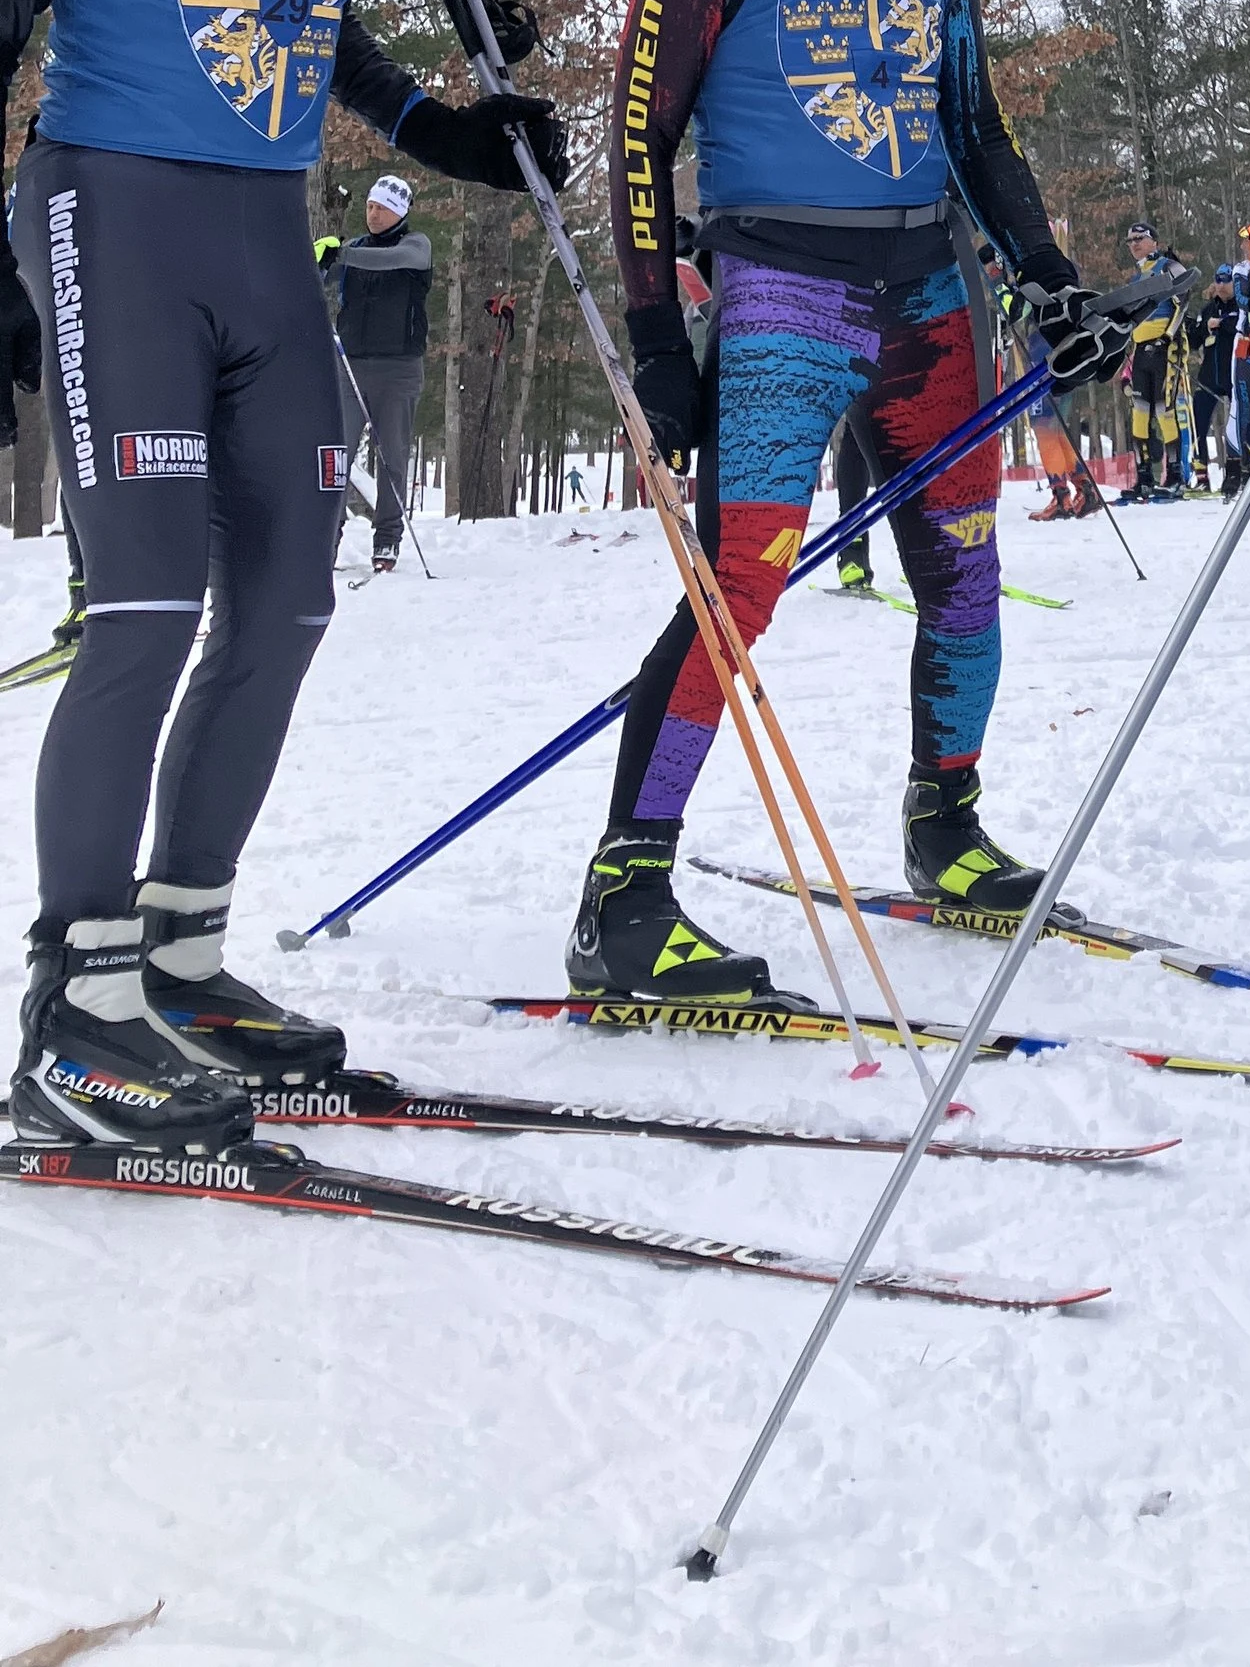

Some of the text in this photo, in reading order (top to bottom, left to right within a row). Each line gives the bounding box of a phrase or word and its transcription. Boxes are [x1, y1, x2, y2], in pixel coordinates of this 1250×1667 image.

[871, 60, 890, 89] 4
[48, 189, 98, 489] NordicSkiRacer.com
[135, 435, 207, 463] NORDIC
[136, 461, 207, 475] SkiRacer.com
[84, 953, 140, 968] SALOMON
[48, 1067, 172, 1110] SALOMON
[406, 1103, 468, 1119] CORNELL
[116, 1156, 256, 1192] ROSSIGNOL
[304, 1182, 363, 1205] CORNELL
